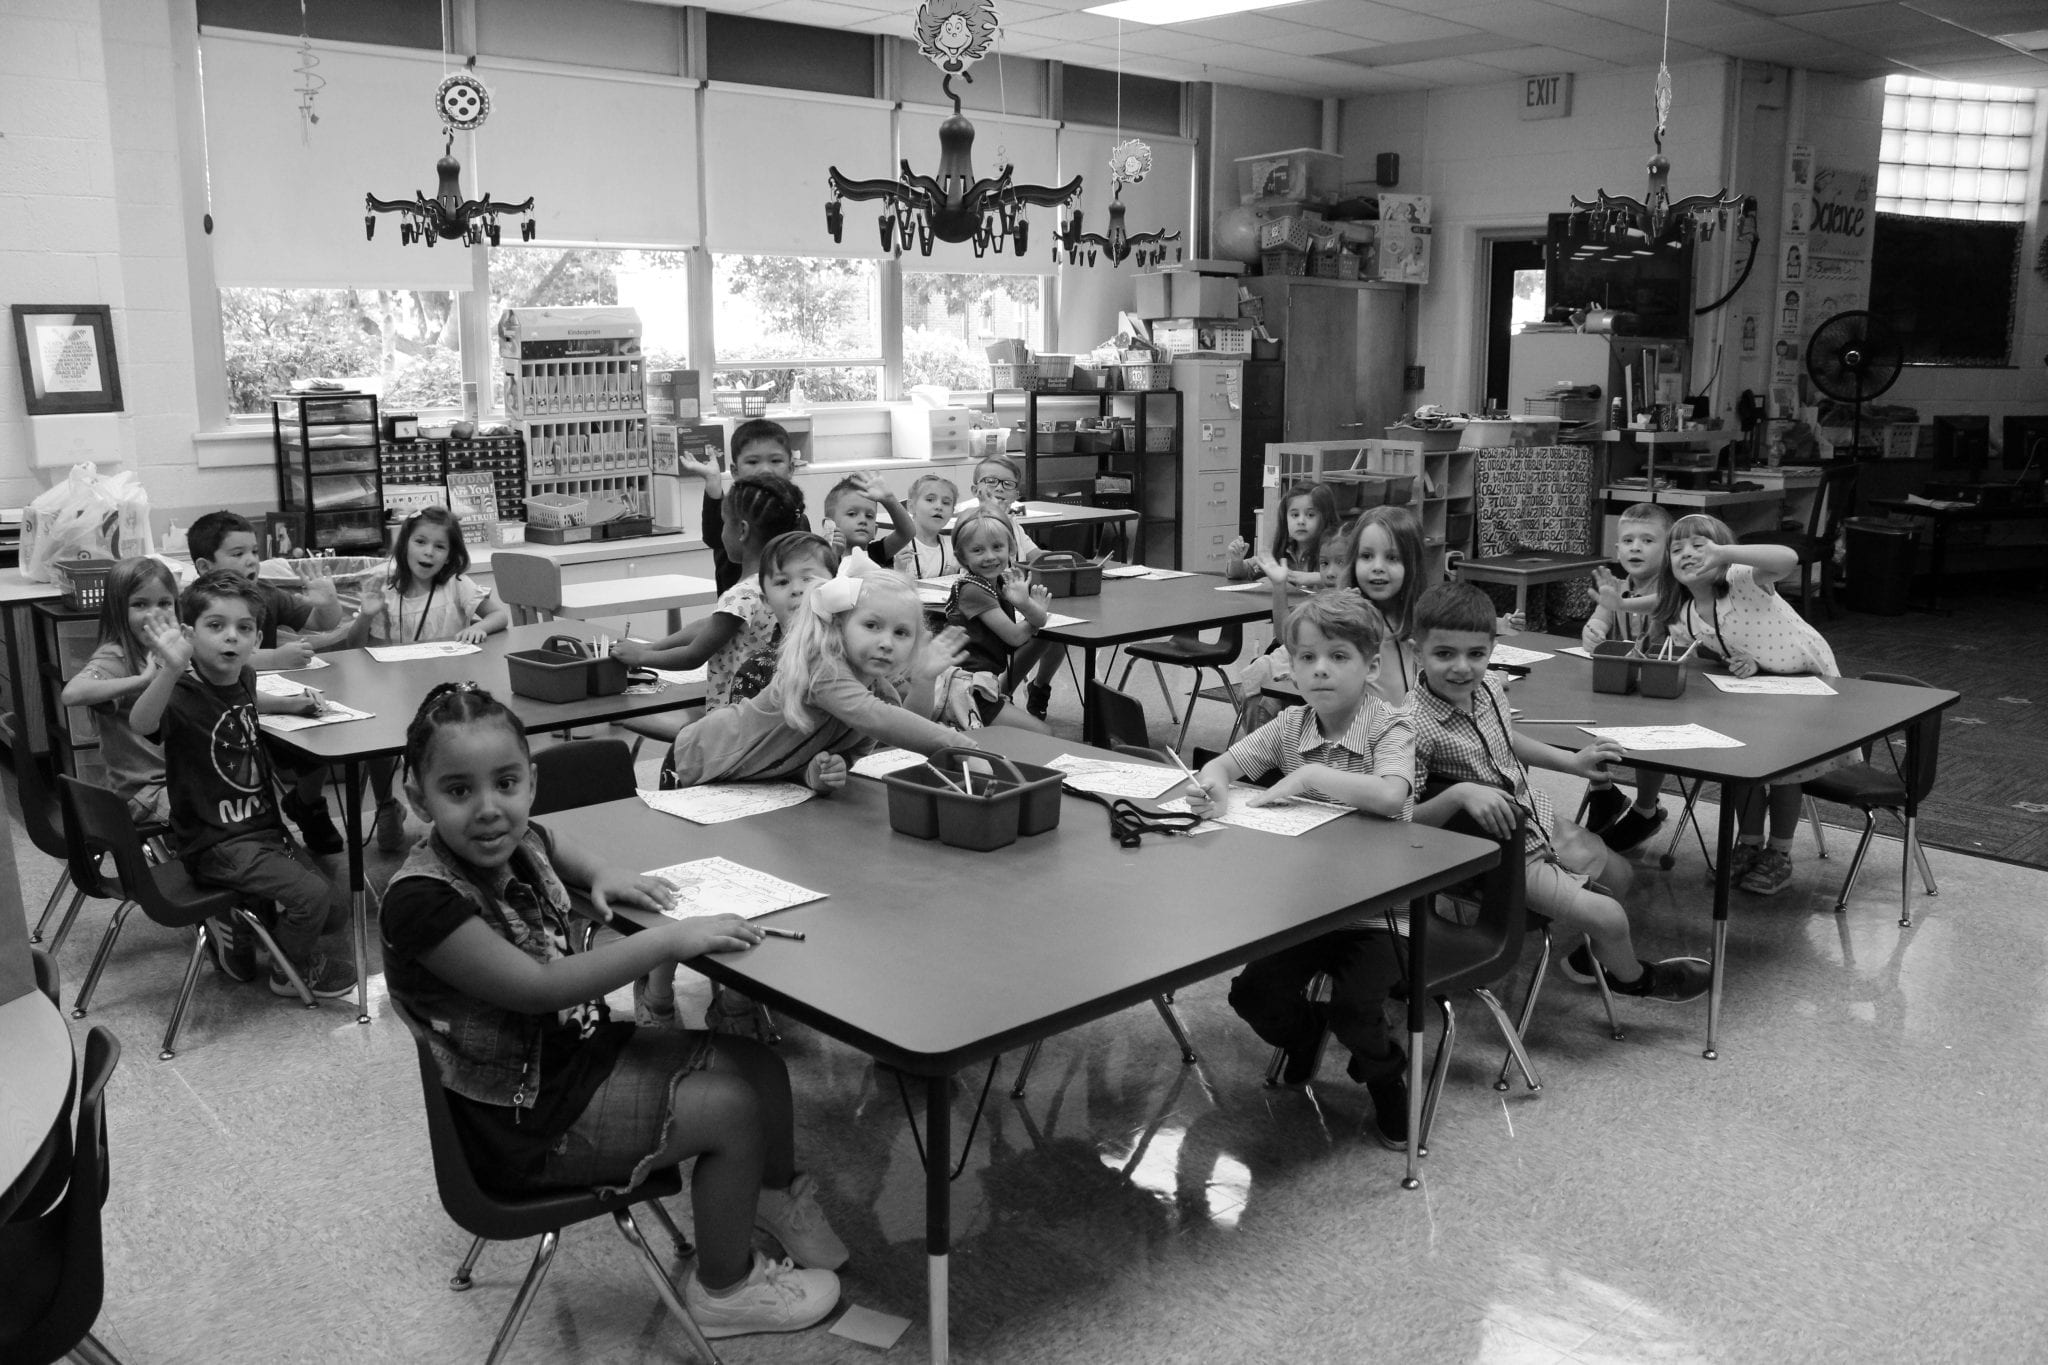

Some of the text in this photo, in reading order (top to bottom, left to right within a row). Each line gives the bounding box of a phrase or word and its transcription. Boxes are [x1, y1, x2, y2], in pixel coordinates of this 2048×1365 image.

[1526, 77, 1560, 107] EXIT
[449, 474, 492, 485] TODAY
[467, 484, 494, 495] You!
